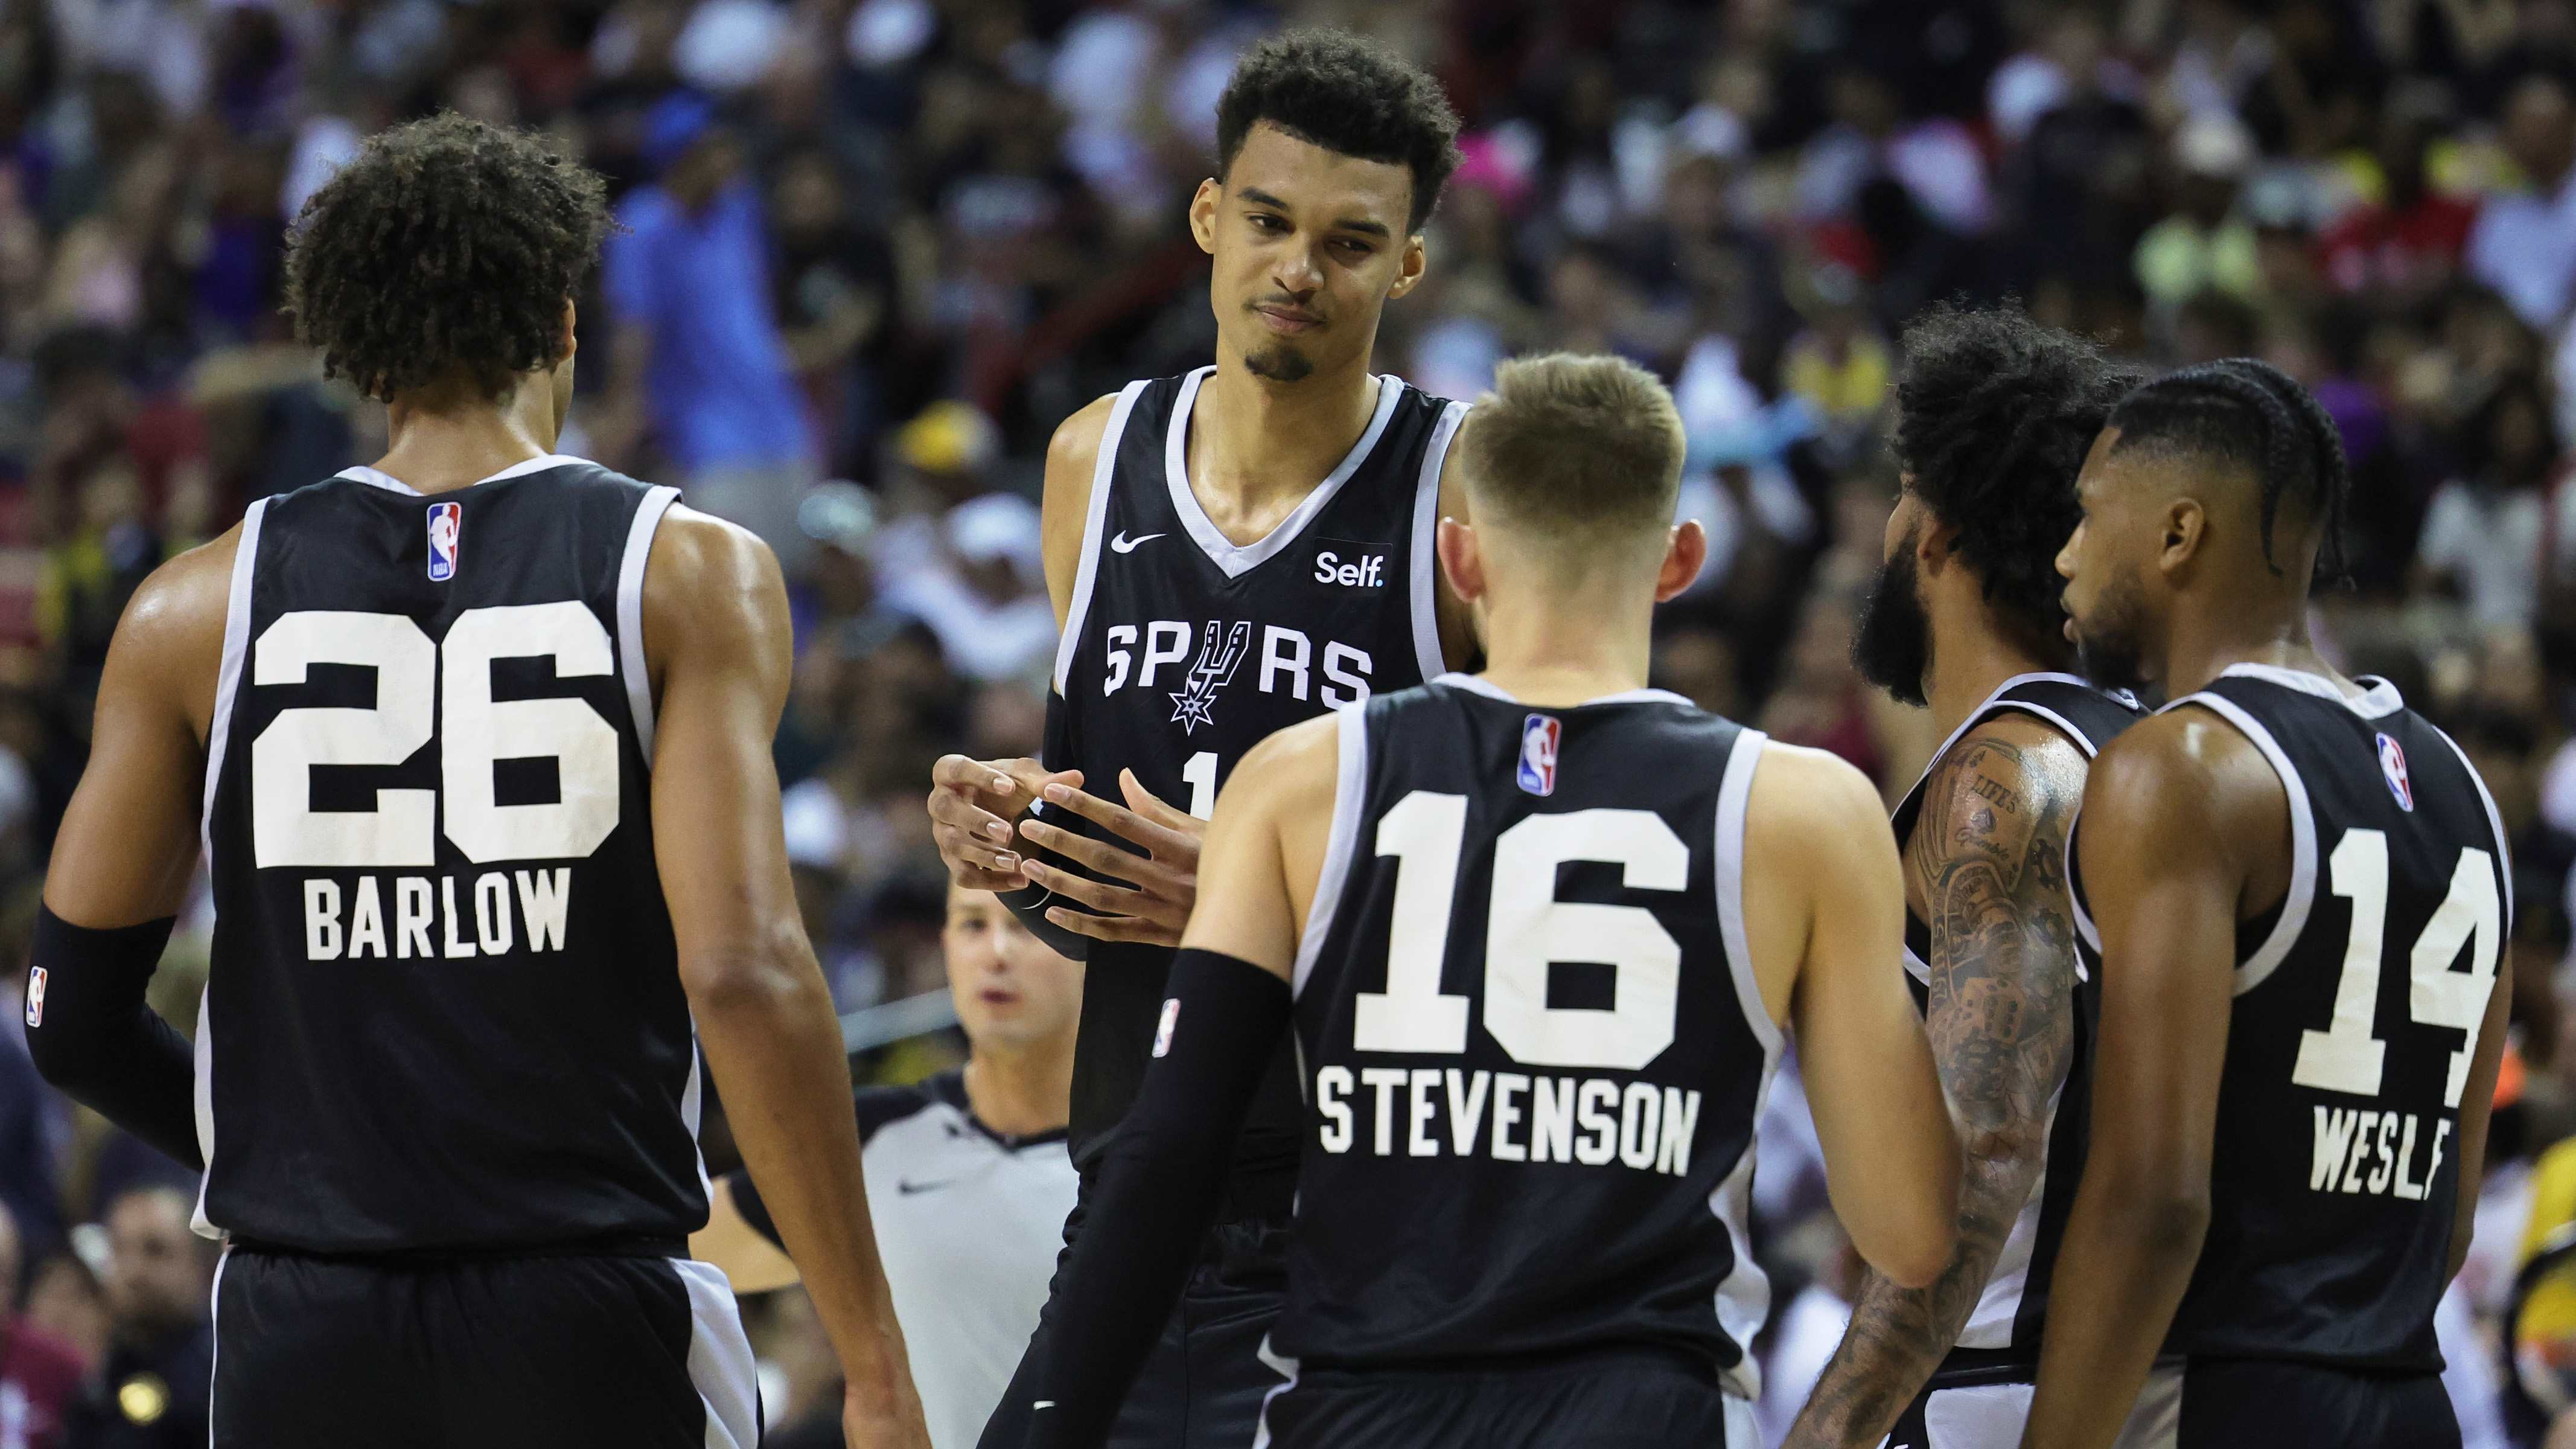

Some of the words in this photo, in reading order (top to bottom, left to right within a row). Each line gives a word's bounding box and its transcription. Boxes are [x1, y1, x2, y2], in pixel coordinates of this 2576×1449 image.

[1315, 552, 1383, 587] Self.
[252, 600, 619, 869] 26
[1103, 620, 1372, 737] SPURS
[1182, 751, 1219, 822] 1
[304, 868, 571, 960] BARLOW
[1353, 790, 1689, 1071] 16
[2292, 828, 2501, 1108] 14
[1317, 1066, 1700, 1176] STEVENSON
